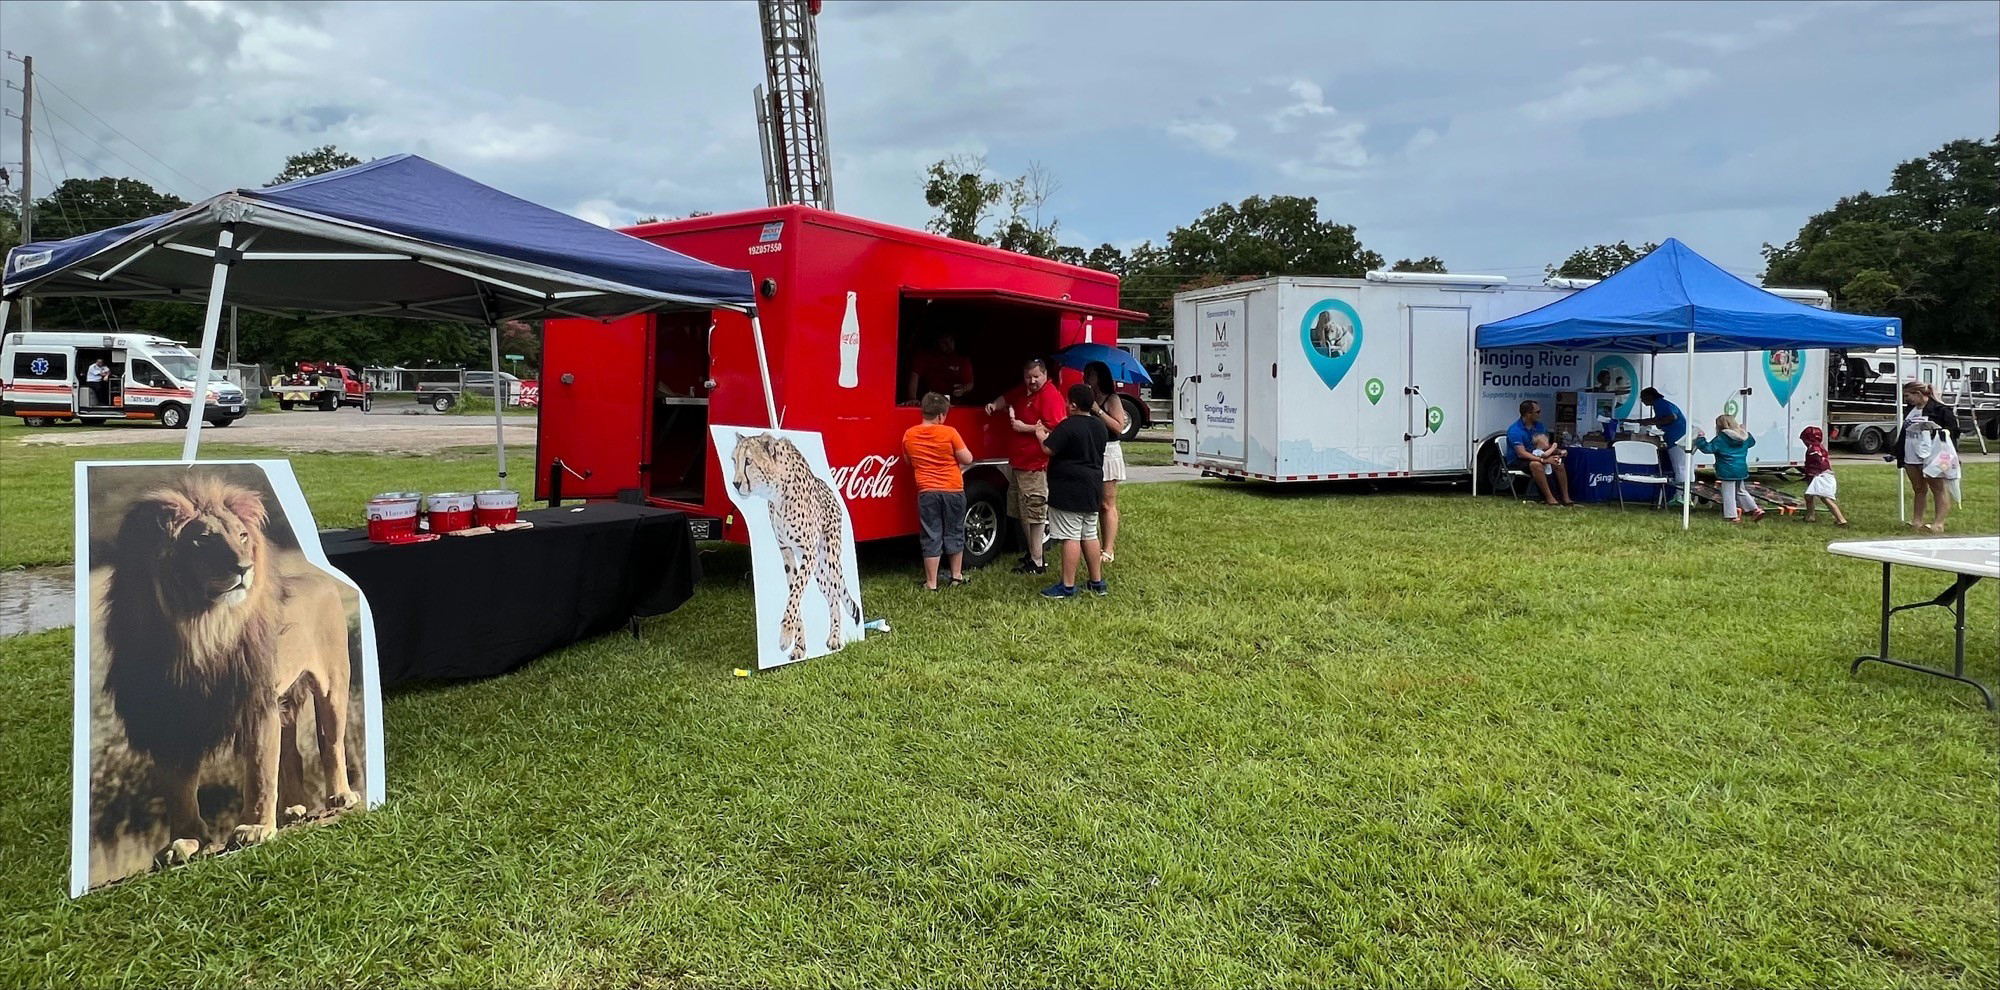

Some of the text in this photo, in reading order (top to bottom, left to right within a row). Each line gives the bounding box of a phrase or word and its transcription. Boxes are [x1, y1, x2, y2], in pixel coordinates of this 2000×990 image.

[1215, 321, 1227, 341] M
[1539, 350, 1579, 367] River
[1482, 371, 1571, 387] Foundation
[1482, 391, 1517, 400] Supporting
[1204, 404, 1238, 415] Singing River
[1206, 414, 1235, 424] Foundation
